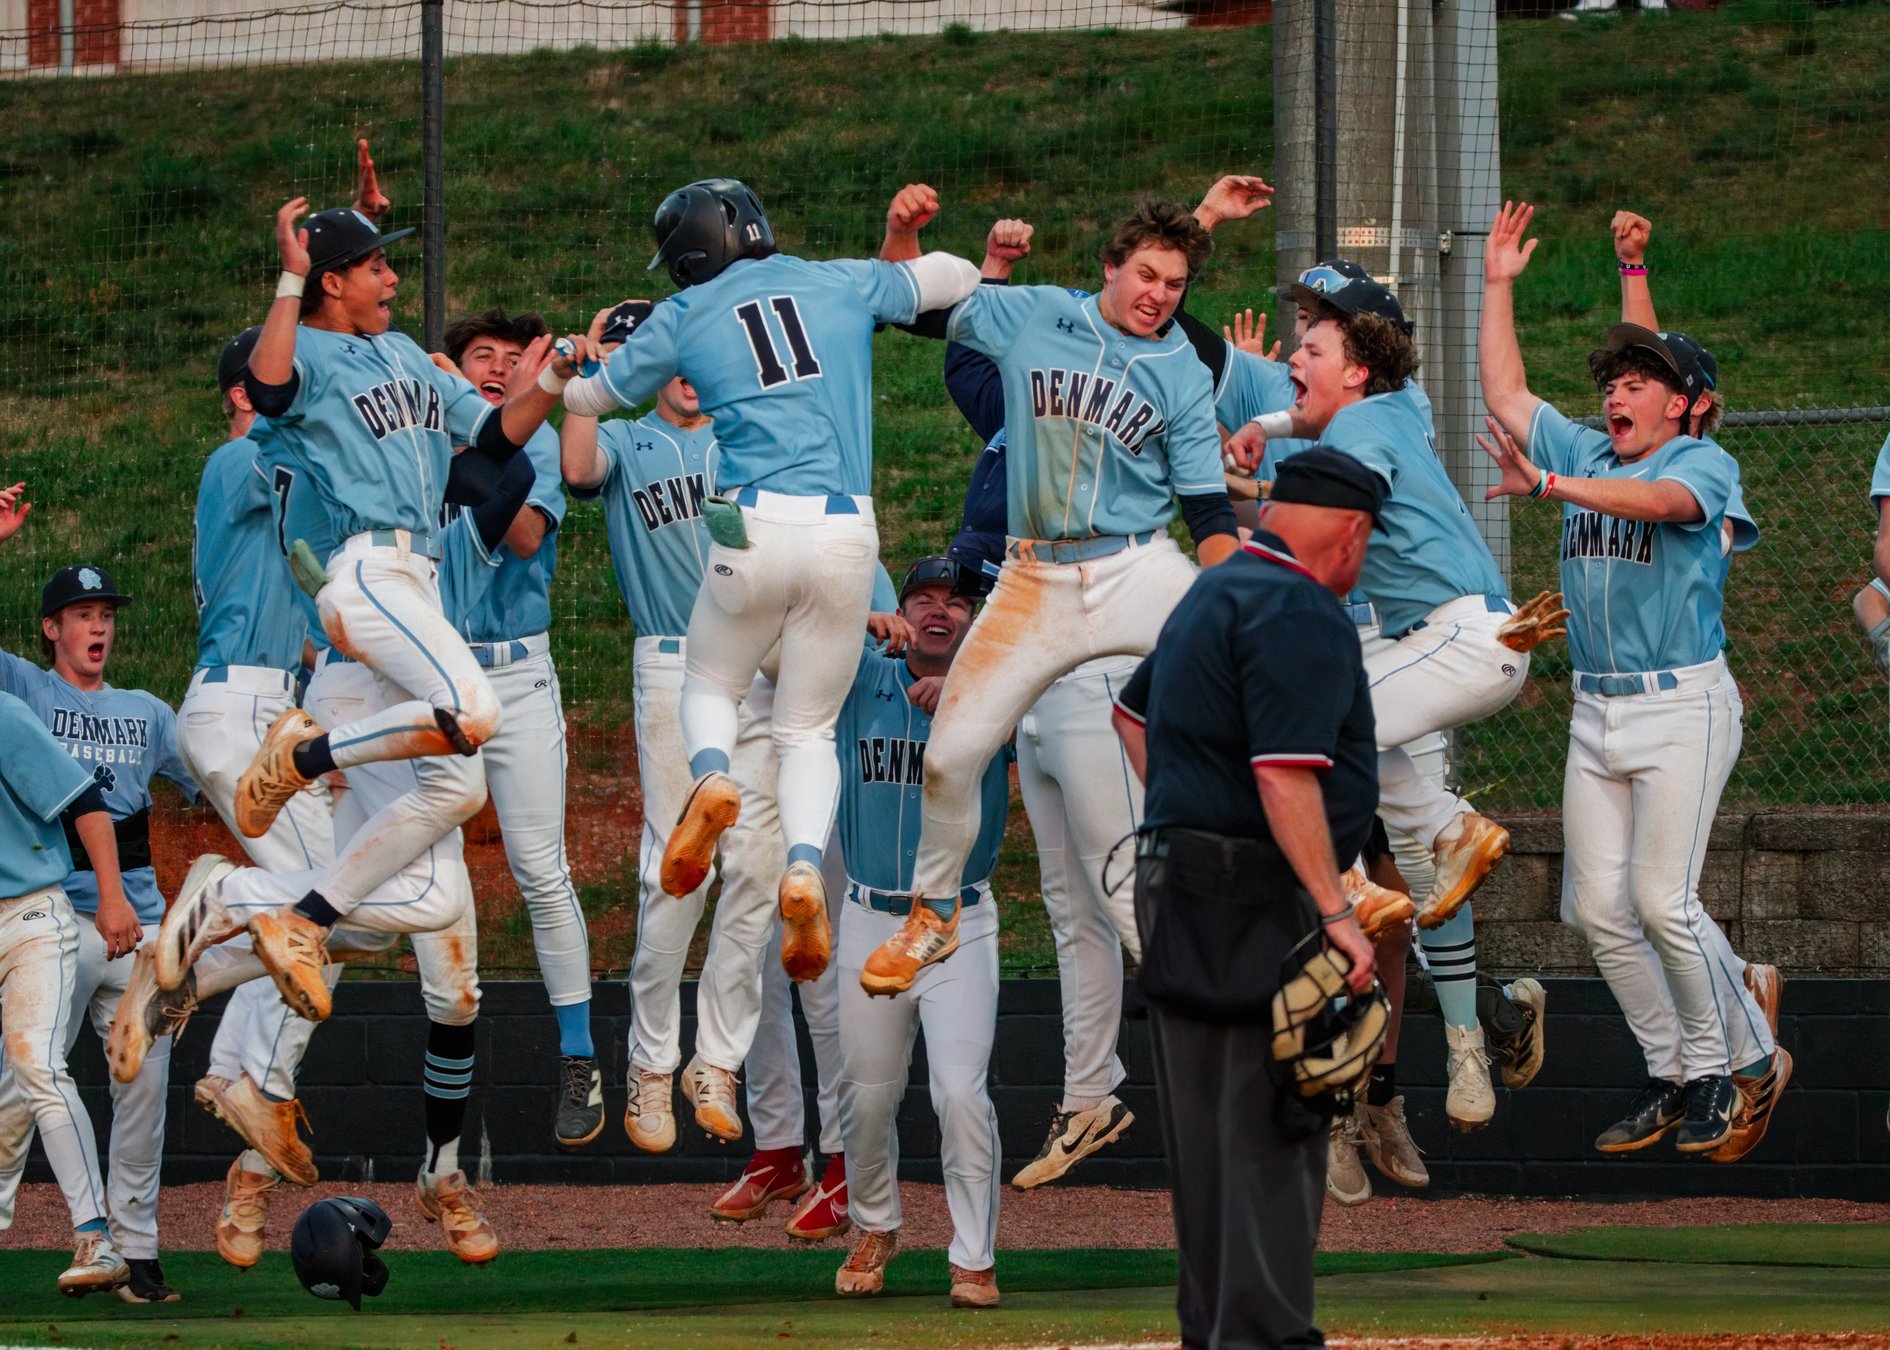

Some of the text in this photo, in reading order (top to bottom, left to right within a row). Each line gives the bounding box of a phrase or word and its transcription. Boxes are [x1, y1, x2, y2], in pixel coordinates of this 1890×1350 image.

[746, 223, 762, 241] 11
[733, 294, 823, 392] 11
[1029, 367, 1168, 458] DENMARK
[1562, 510, 1659, 566] DENMARK
[51, 706, 148, 750] DENMARK
